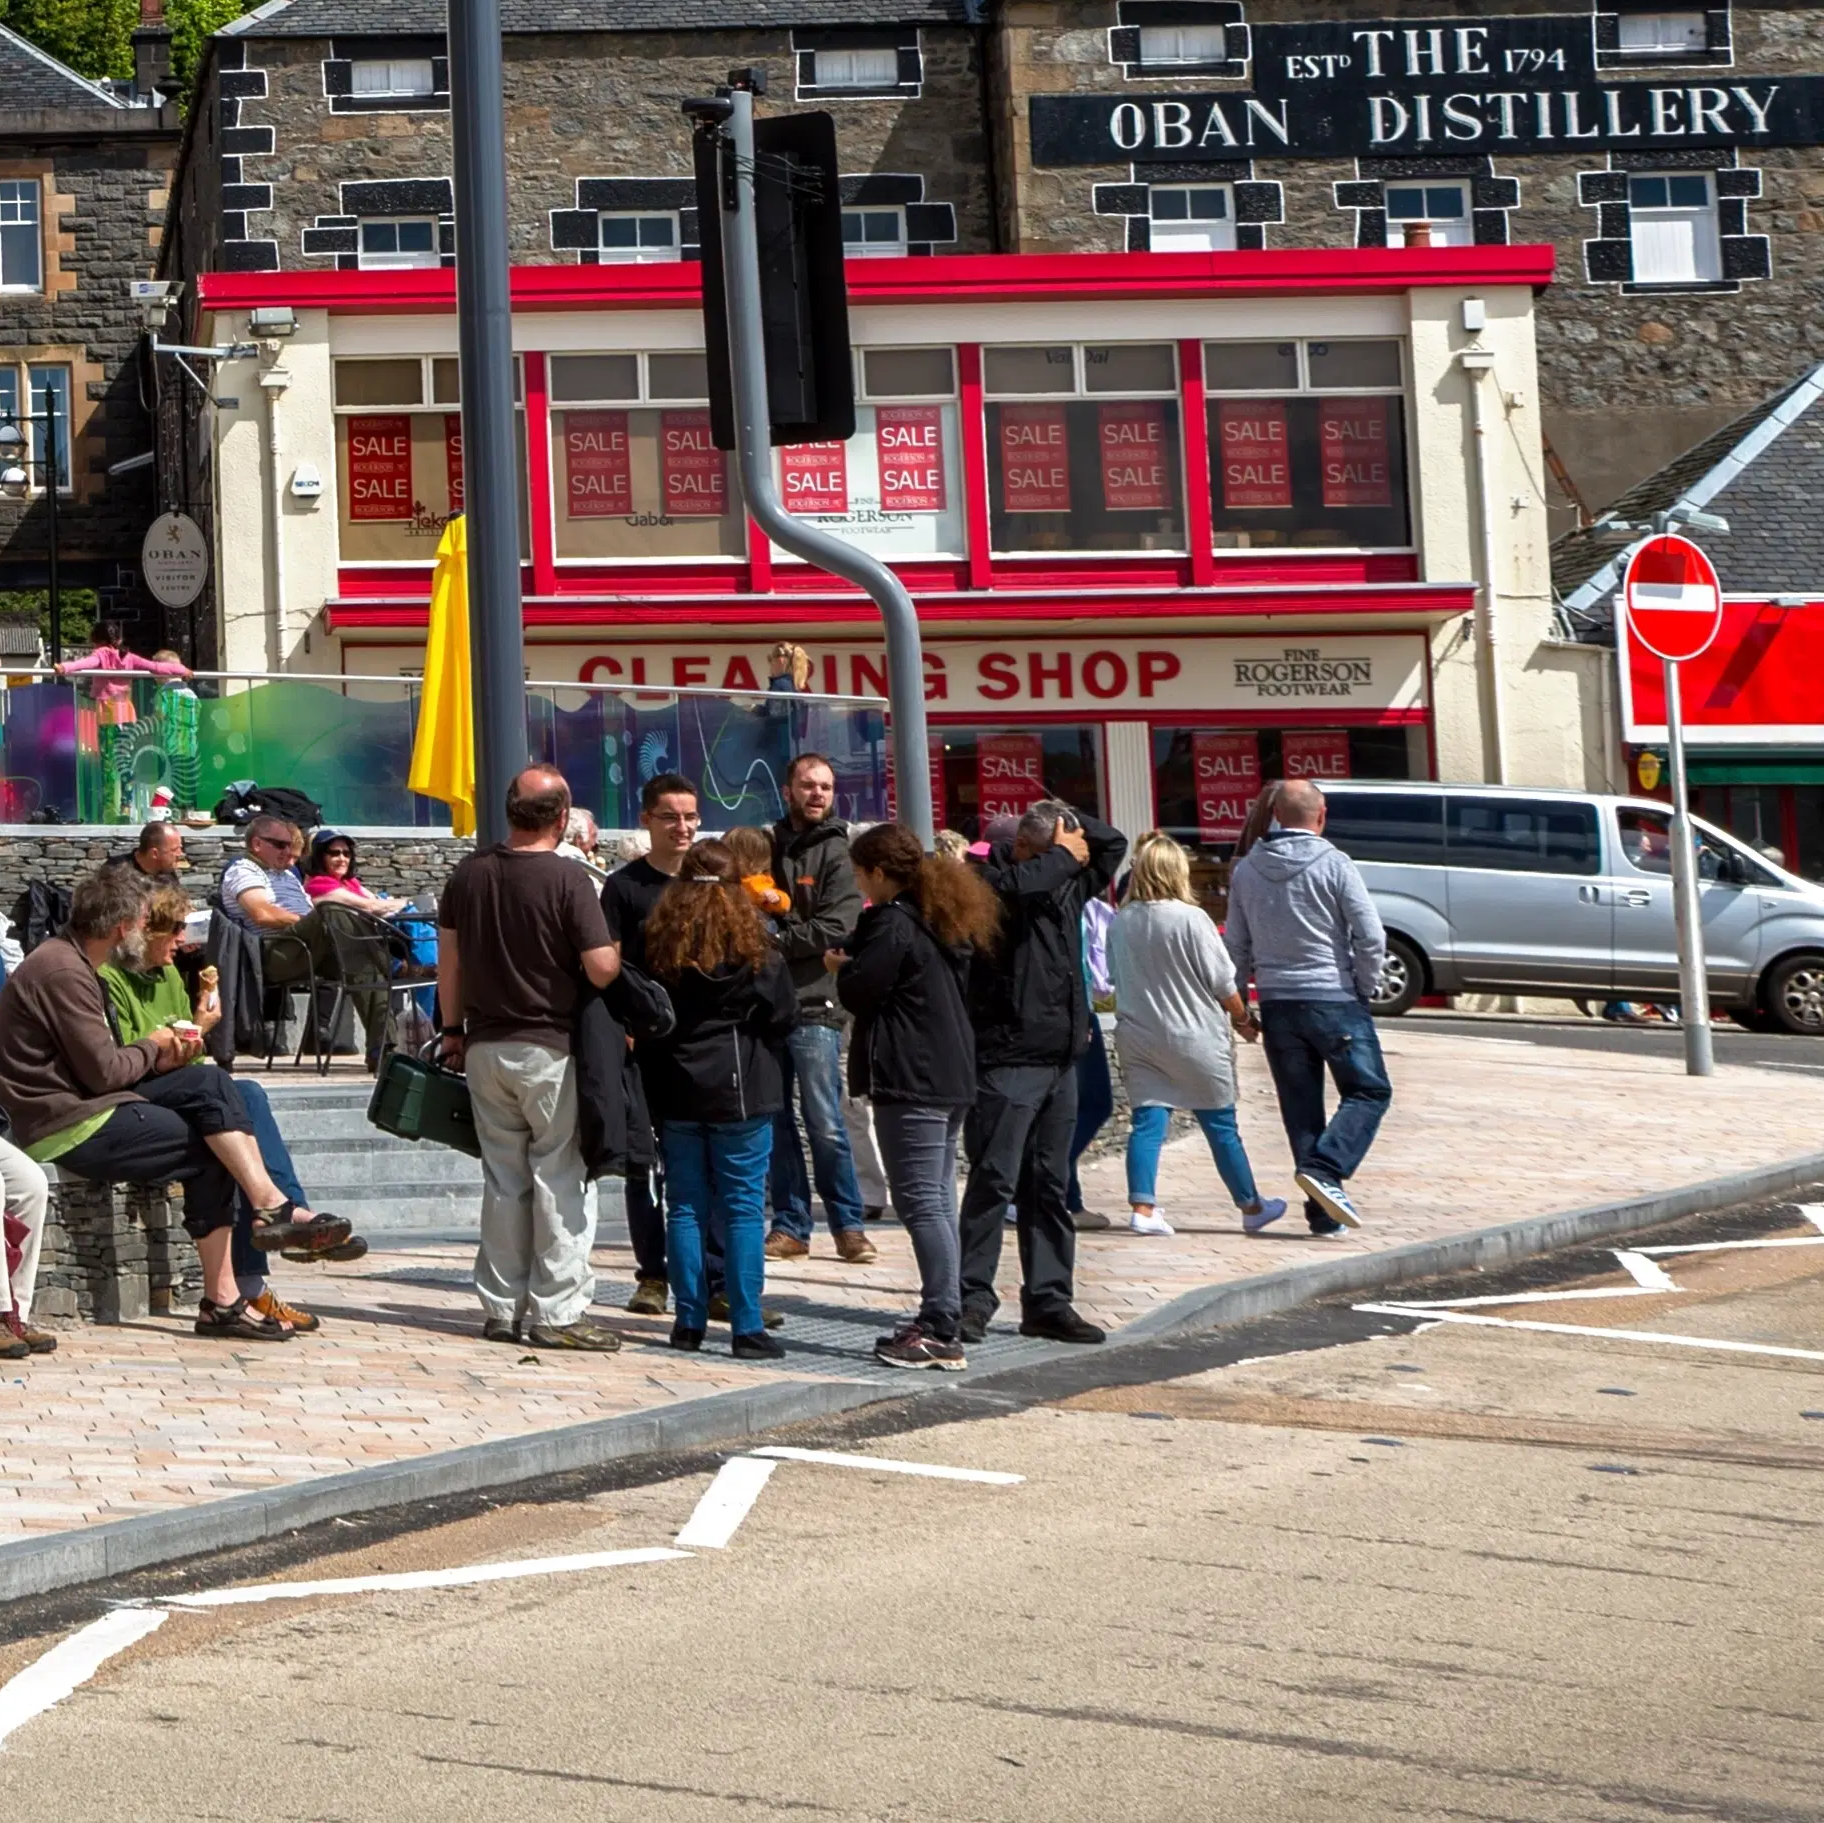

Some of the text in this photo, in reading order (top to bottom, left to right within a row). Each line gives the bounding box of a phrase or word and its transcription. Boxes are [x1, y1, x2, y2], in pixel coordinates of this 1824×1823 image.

[1353, 27, 1490, 78] THE
[1504, 47, 1567, 74] 1794
[1110, 85, 1780, 150] OBAN DISTILLERY
[881, 426, 938, 447] SALE
[1005, 424, 1062, 445] SALE
[1104, 422, 1161, 444] SALE
[1225, 421, 1283, 442] SALE
[1324, 419, 1382, 440] SALE
[353, 436, 407, 456] SALE
[569, 431, 625, 452] SALE
[668, 473, 723, 493] SALE
[786, 471, 843, 492] SALE
[883, 469, 940, 490] SALE
[1008, 468, 1065, 488] SALE
[1107, 466, 1165, 487] SALE
[1227, 464, 1285, 485] SALE
[1327, 463, 1385, 484] SALE
[354, 478, 408, 499] SALE
[571, 474, 626, 495] SALE
[149, 550, 201, 559] OBAN
[1284, 649, 1320, 661] FINE
[978, 650, 1181, 701] SHOP
[1234, 662, 1372, 683] ROGERSON
[1257, 682, 1352, 697] FOOTWEAR
[982, 757, 1038, 778] SALE
[1199, 755, 1255, 777] SALE
[1288, 754, 1346, 775] SALE
